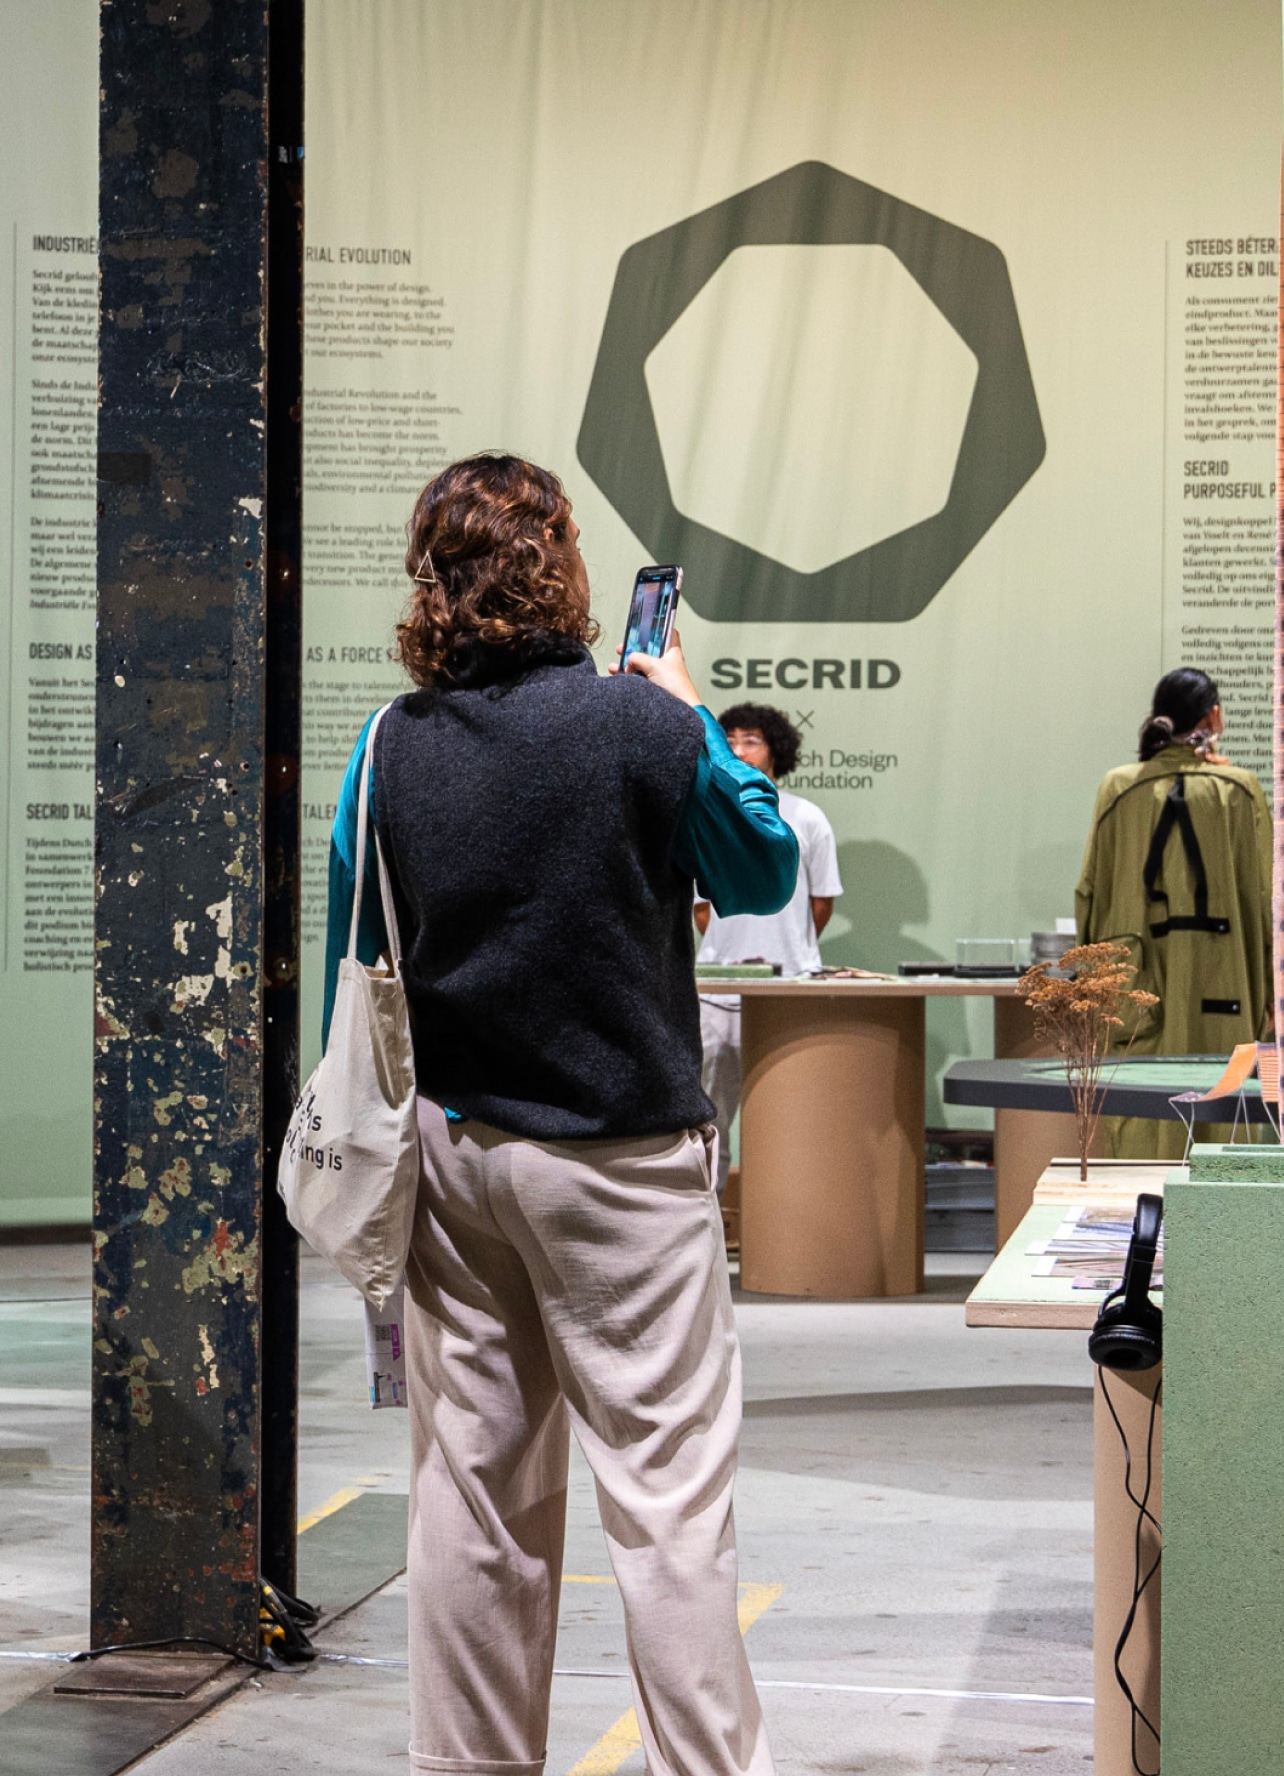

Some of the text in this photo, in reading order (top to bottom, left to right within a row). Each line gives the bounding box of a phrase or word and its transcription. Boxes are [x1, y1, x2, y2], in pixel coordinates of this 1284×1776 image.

[1186, 235, 1278, 255] STEEDS BÉTER
[339, 248, 411, 265] EVOLUTION
[1186, 262, 1233, 278] KEUZES
[1237, 261, 1253, 277] EN
[1184, 460, 1229, 476] SECRID
[1184, 482, 1264, 499] PURPOSEFUL
[29, 643, 92, 660] DESIGN AS
[306, 647, 383, 664] AS A FORCE
[711, 658, 901, 689] SECRID
[830, 750, 898, 773] Design
[27, 803, 69, 820] SECRID
[302, 804, 336, 820] TALE
[329, 1148, 342, 1171] is
